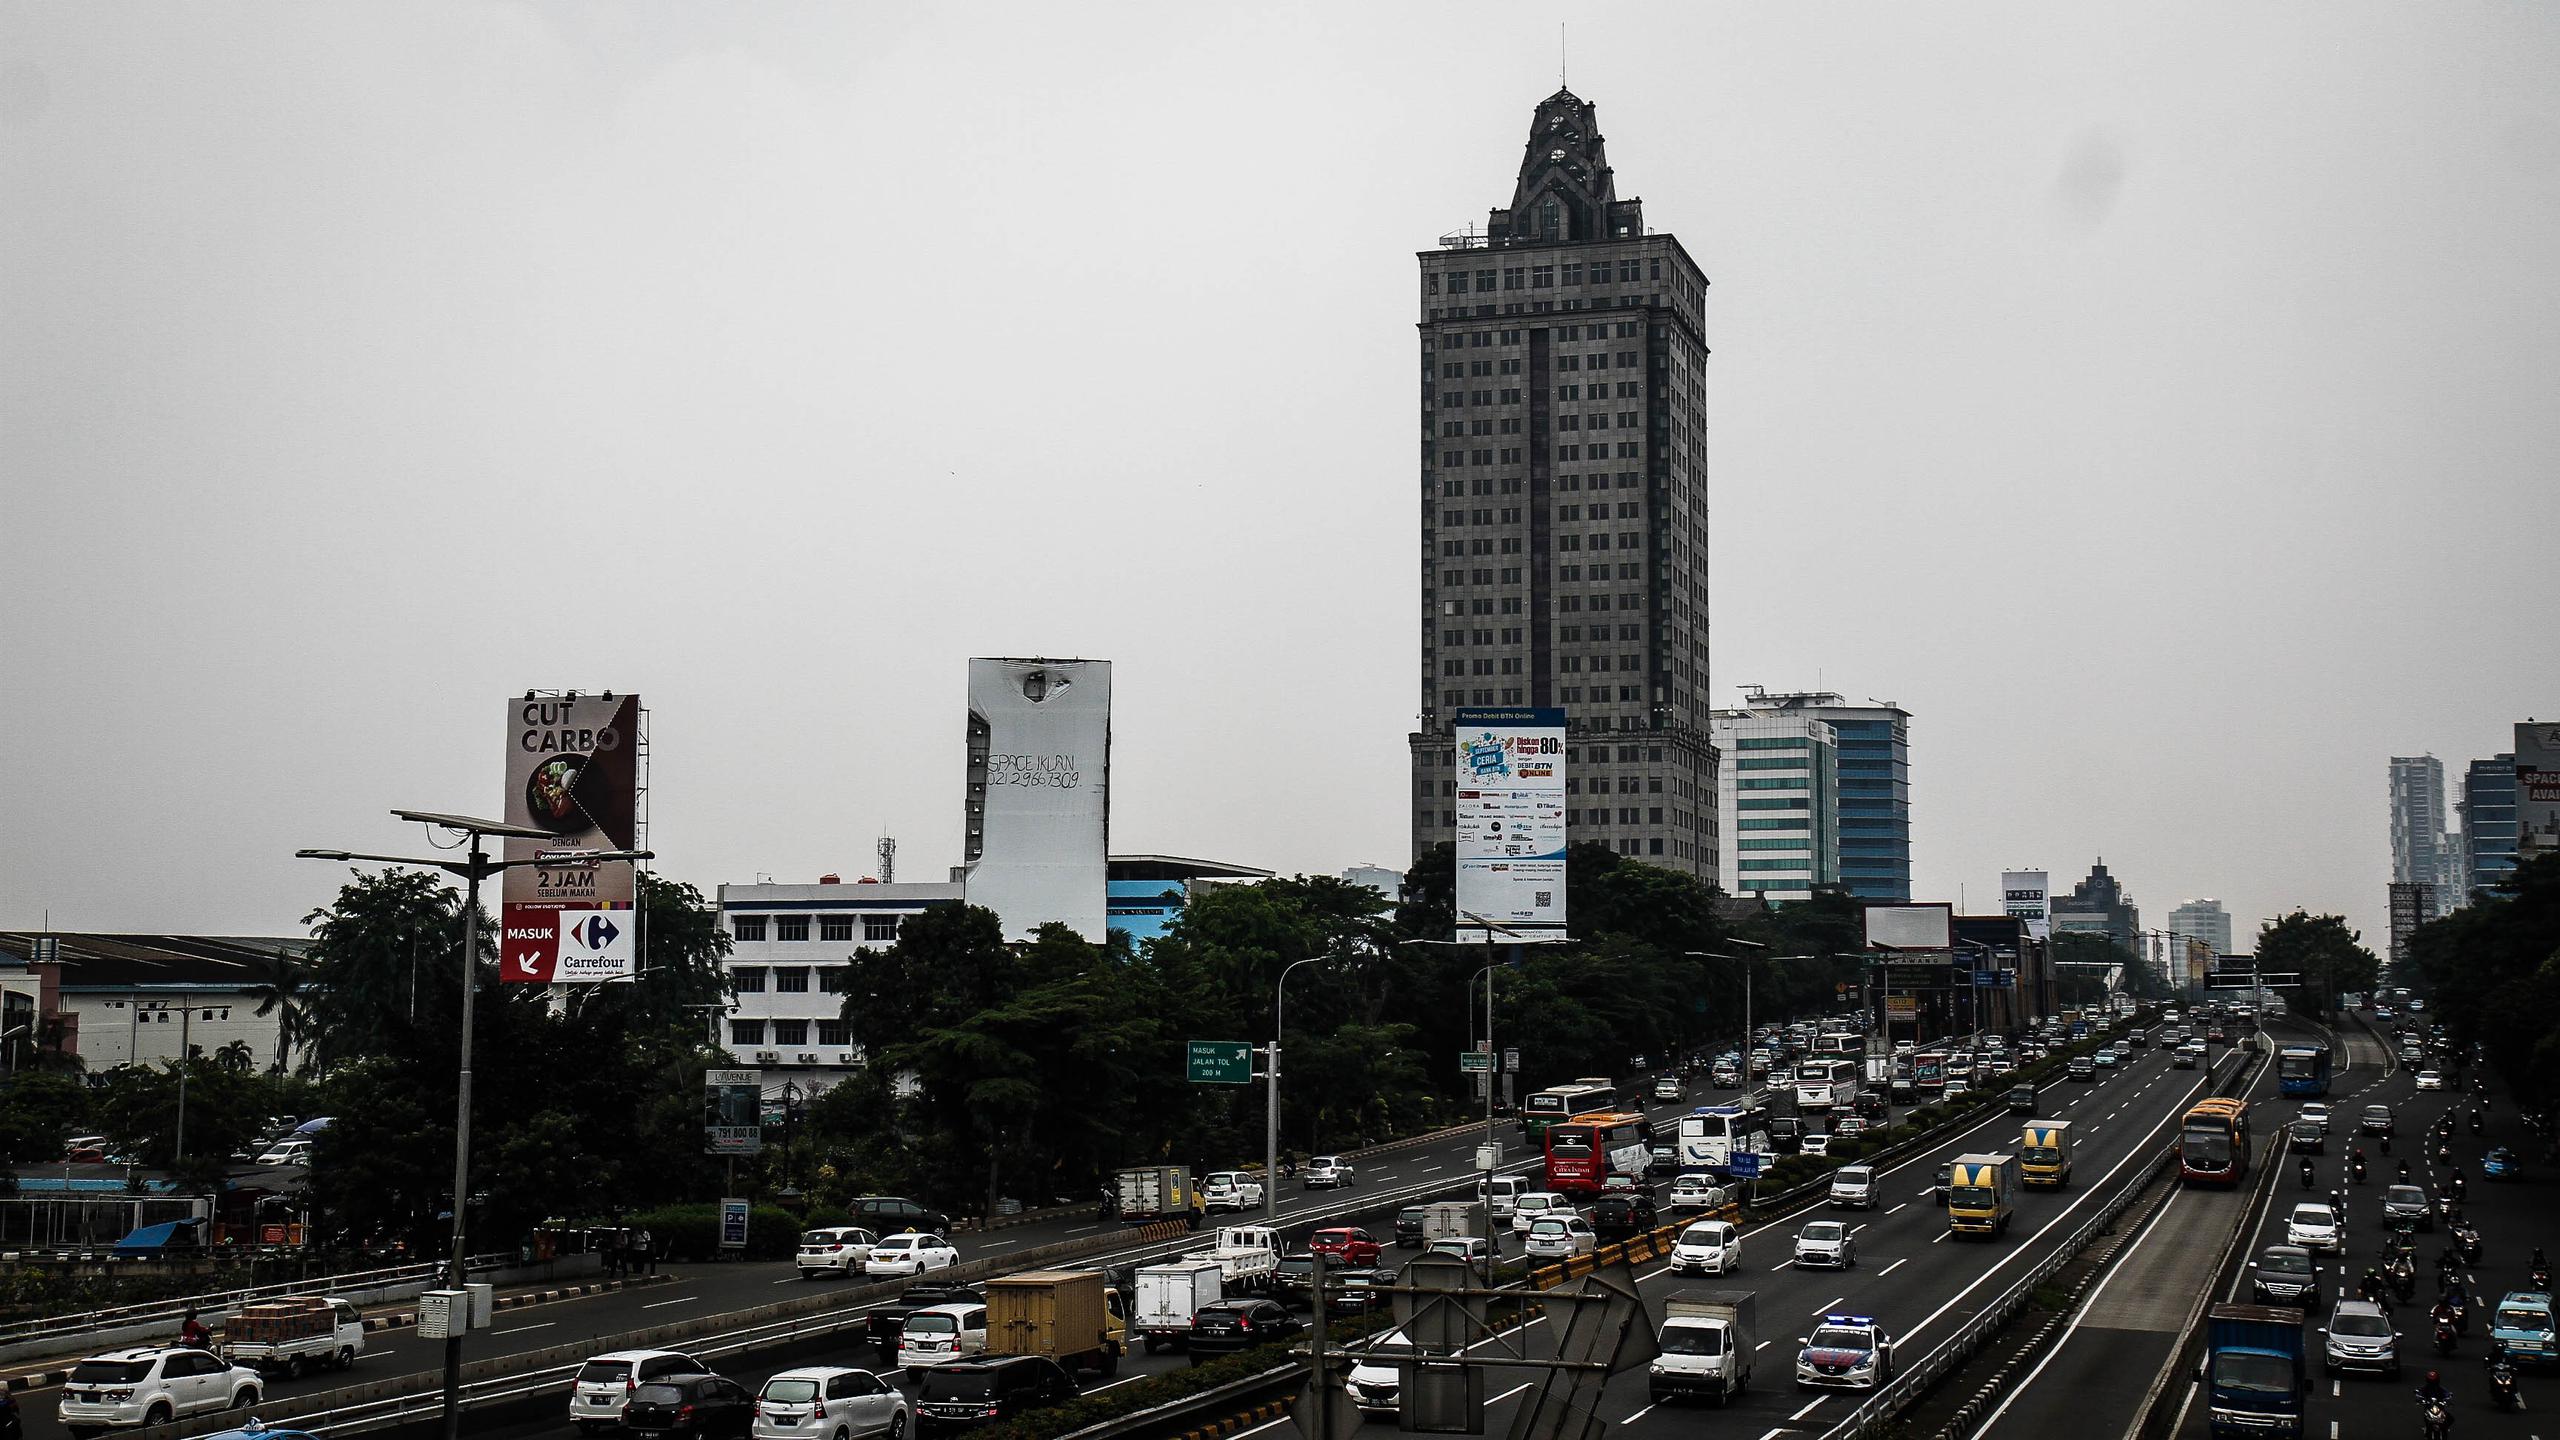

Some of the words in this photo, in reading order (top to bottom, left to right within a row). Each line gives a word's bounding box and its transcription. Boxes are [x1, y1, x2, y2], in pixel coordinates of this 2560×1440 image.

[522, 702, 573, 726] CUT
[521, 727, 620, 752] CARBO
[1517, 737, 1539, 745] Diskon
[1517, 746, 1539, 755] hingga
[1540, 737, 1563, 755] 80%
[987, 754, 1033, 772] SPACE
[1037, 755, 1074, 771] IKLAN
[1477, 754, 1496, 765] CERIA
[987, 772, 1007, 785] 021
[552, 838, 581, 848] DENGAN
[538, 871, 550, 887] 2
[554, 871, 595, 887] JAM
[537, 889, 567, 898] SEBELUM
[570, 888, 596, 897] MAKAN
[507, 928, 553, 939] MASUK
[564, 956, 625, 968] Carrefour
[1217, 1058, 1230, 1066] TOL
[718, 1128, 731, 1138] 791
